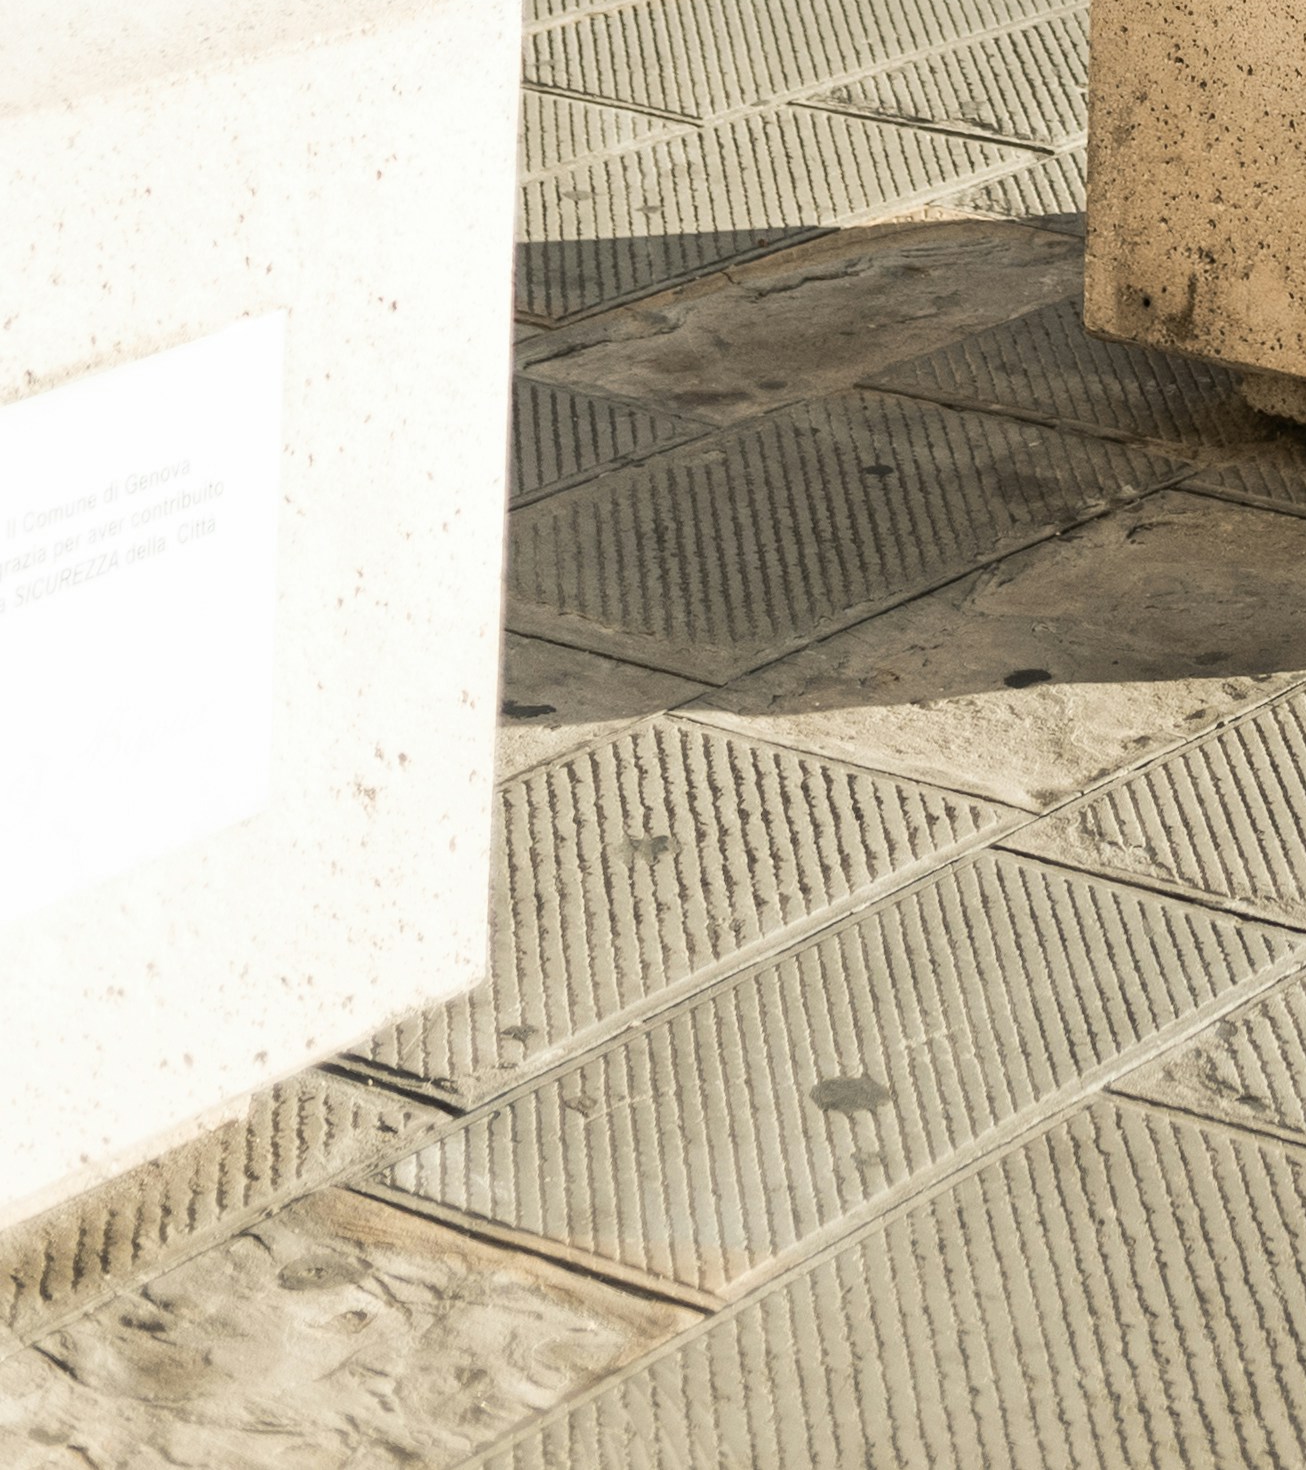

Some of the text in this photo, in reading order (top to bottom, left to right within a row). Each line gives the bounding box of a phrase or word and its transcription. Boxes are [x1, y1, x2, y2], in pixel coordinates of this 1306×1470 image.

[22, 492, 97, 534] Comune
[102, 479, 119, 504] di
[124, 458, 192, 496] Genova
[52, 533, 81, 563] per
[87, 515, 125, 545] aver
[131, 479, 225, 527] contribuito
[14, 549, 120, 608] SICUREZZA
[125, 535, 168, 565] della
